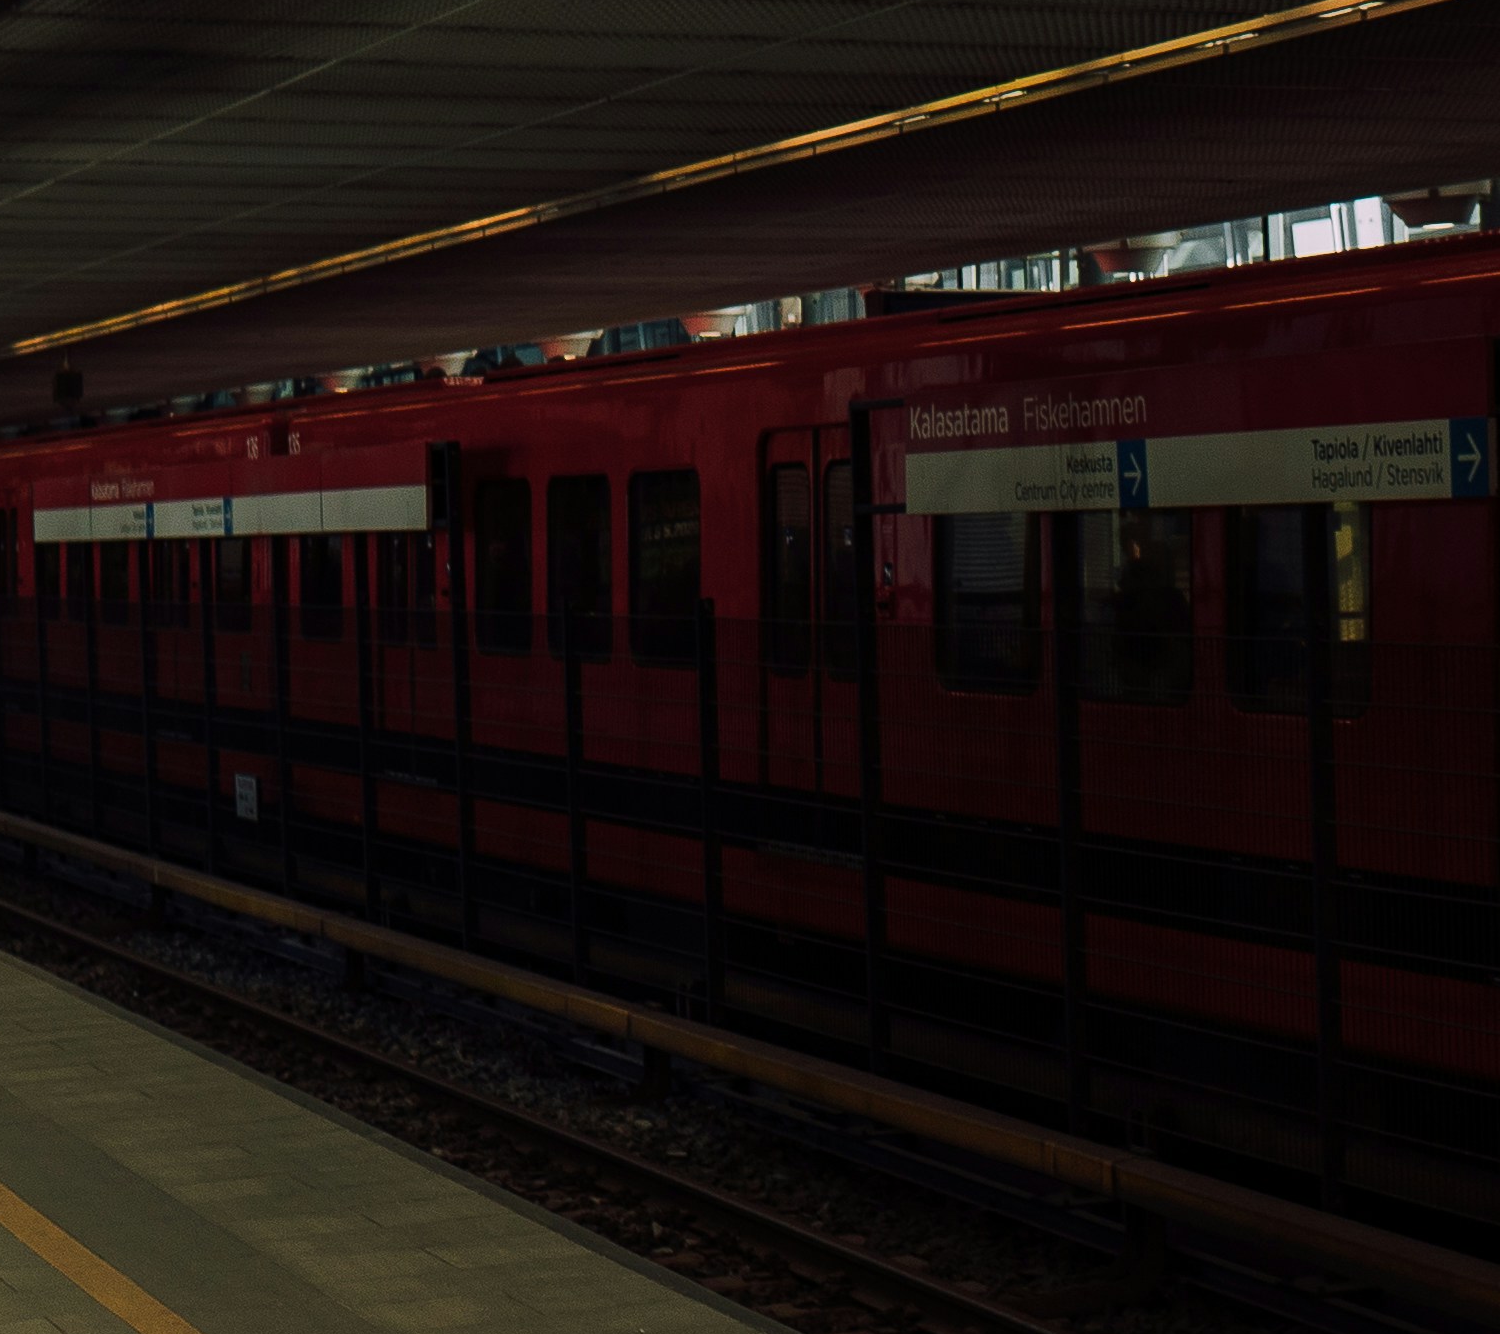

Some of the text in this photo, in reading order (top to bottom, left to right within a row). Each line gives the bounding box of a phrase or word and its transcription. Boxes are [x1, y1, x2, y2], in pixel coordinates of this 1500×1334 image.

[910, 392, 1147, 440] Kalasatama Fiskehamnen
[1311, 435, 1359, 463] Tapiola
[1372, 430, 1443, 458] Kivenlahti
[1066, 454, 1113, 474] Keskusta
[1311, 465, 1373, 492] Hagalund
[1386, 462, 1444, 487] Stensvik
[1014, 480, 1114, 502] Centrum City centre
